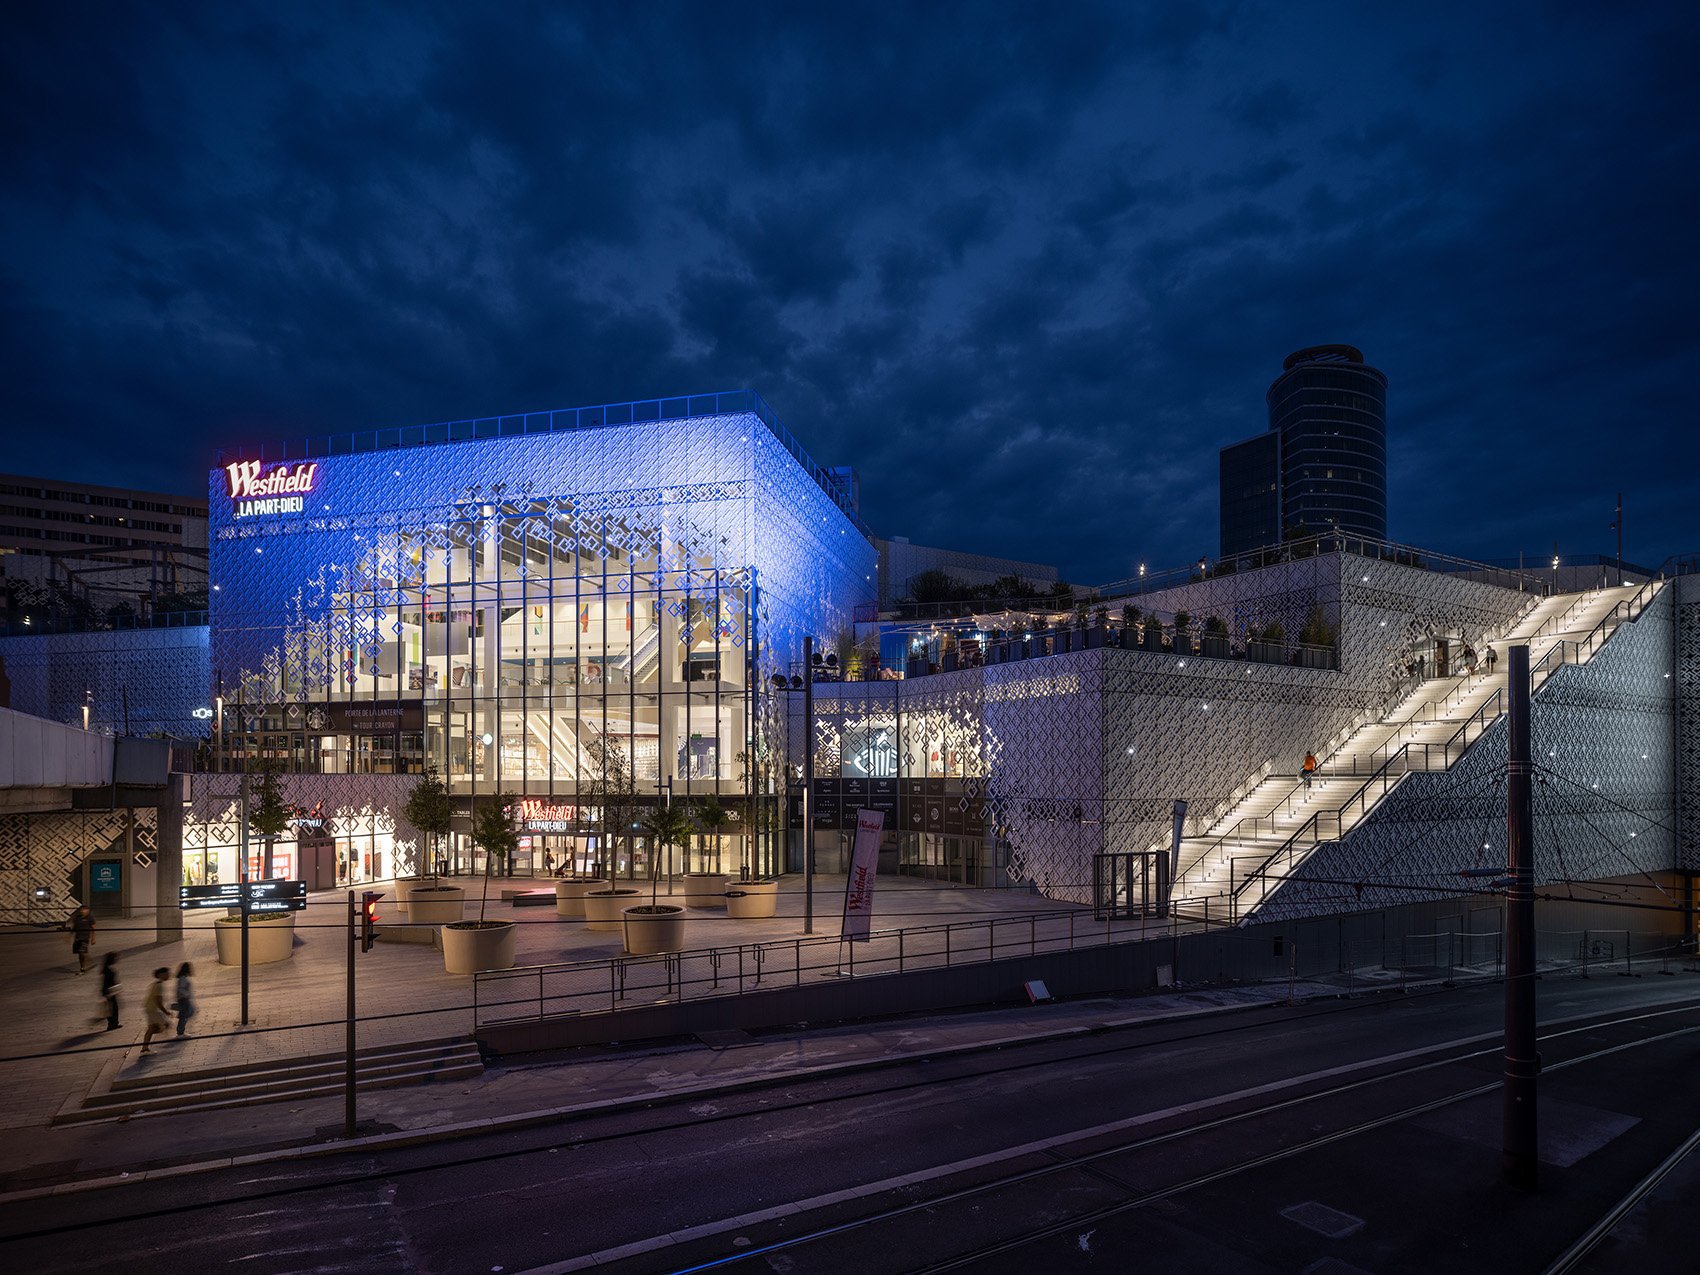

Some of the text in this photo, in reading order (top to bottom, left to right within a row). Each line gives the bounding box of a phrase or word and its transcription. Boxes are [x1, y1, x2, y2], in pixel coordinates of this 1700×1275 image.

[226, 459, 318, 498] Westfield
[240, 496, 304, 517] LA PART-DIEU
[345, 709, 362, 717] PORTE
[362, 709, 369, 717] DE
[378, 708, 404, 716] LANTERNE
[375, 721, 395, 729] CRAYON
[521, 799, 574, 821] Westfield
[528, 821, 538, 830] LA
[859, 820, 881, 831] Westfield
[272, 856, 288, 868] UNI
[849, 864, 867, 911] Westfield
